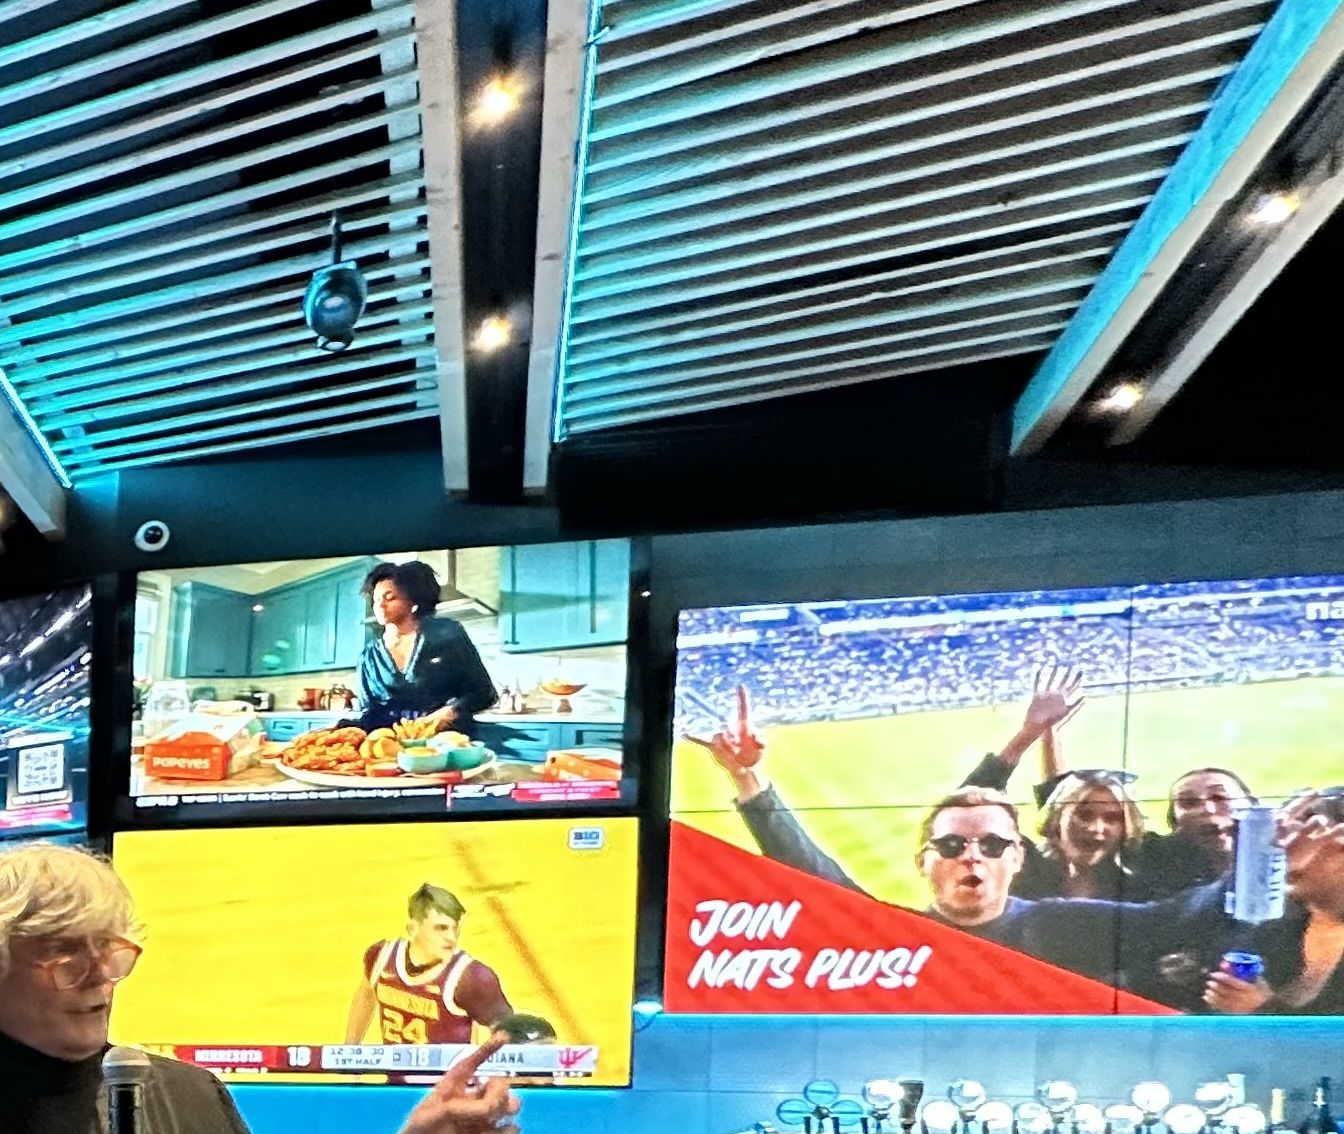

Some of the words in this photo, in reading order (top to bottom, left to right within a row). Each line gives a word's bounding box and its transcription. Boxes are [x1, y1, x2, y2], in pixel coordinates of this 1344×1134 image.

[689, 900, 802, 947] JOIN
[687, 947, 803, 991] NATS
[805, 945, 933, 991] PLUS!
[383, 1007, 428, 1045] 24
